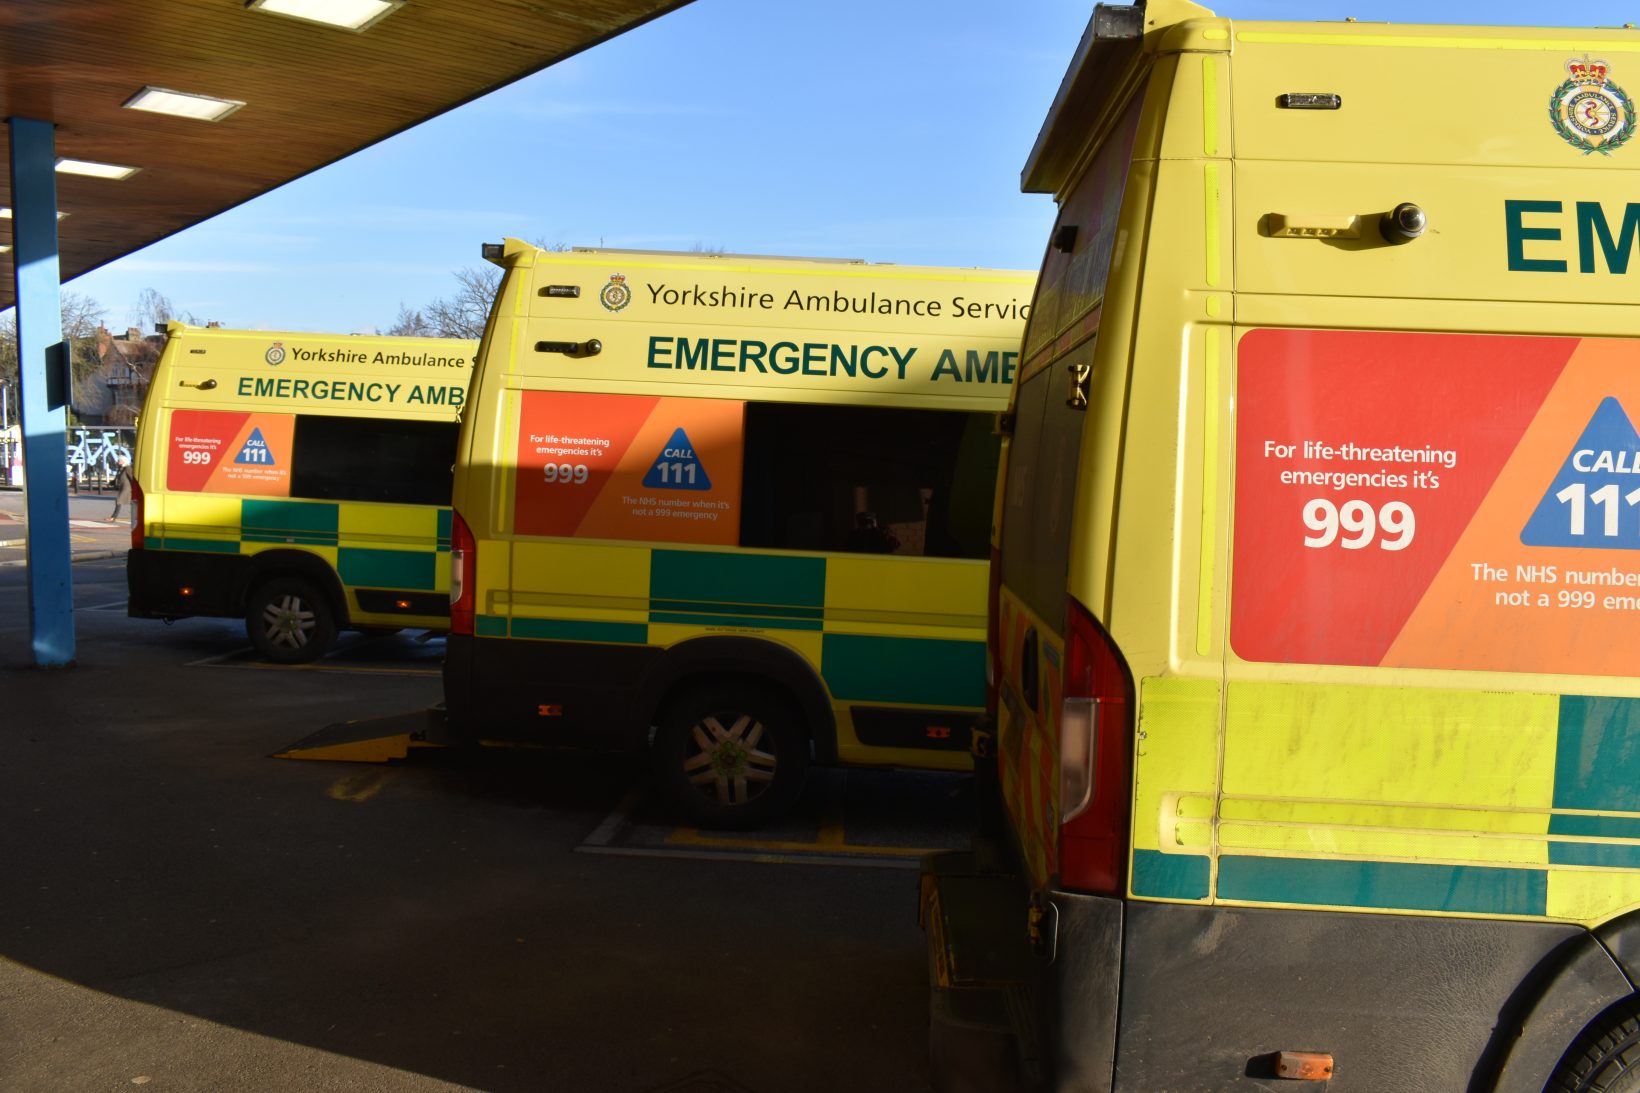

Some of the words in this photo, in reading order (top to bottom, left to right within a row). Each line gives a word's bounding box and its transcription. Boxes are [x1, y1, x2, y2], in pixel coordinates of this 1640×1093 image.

[1505, 200, 1640, 274] EM
[647, 283, 774, 309] Yorkshire
[783, 290, 942, 317] Ambulance
[291, 348, 367, 364] Yorkshire
[372, 351, 465, 368] Ambulance
[647, 336, 918, 380] EMERGENCY
[237, 377, 401, 403] EMERGENCY
[407, 385, 465, 406] AMB
[530, 434, 544, 443] For
[545, 435, 610, 447] life-threatening
[536, 445, 589, 456] emergencies
[590, 447, 602, 456] it's
[183, 450, 211, 464] 999
[243, 448, 266, 462] 111
[664, 448, 693, 459] CALL
[1264, 440, 1296, 458] For
[1303, 440, 1456, 468] life-threatening
[543, 462, 589, 484] 999
[657, 462, 696, 484] 111
[1280, 469, 1408, 491] emergencies
[1413, 470, 1440, 489] it's
[622, 496, 637, 505] The
[639, 497, 657, 506] NHS
[658, 498, 691, 508] number
[691, 499, 716, 508] when
[632, 508, 647, 516] not
[655, 509, 670, 517] 999
[672, 510, 718, 520] emergency
[1302, 498, 1416, 551] 999
[1471, 563, 1508, 582] The
[1516, 565, 1557, 583] NHS
[1495, 590, 1530, 606] not
[1537, 593, 1549, 607] a
[1558, 590, 1595, 608] 999
